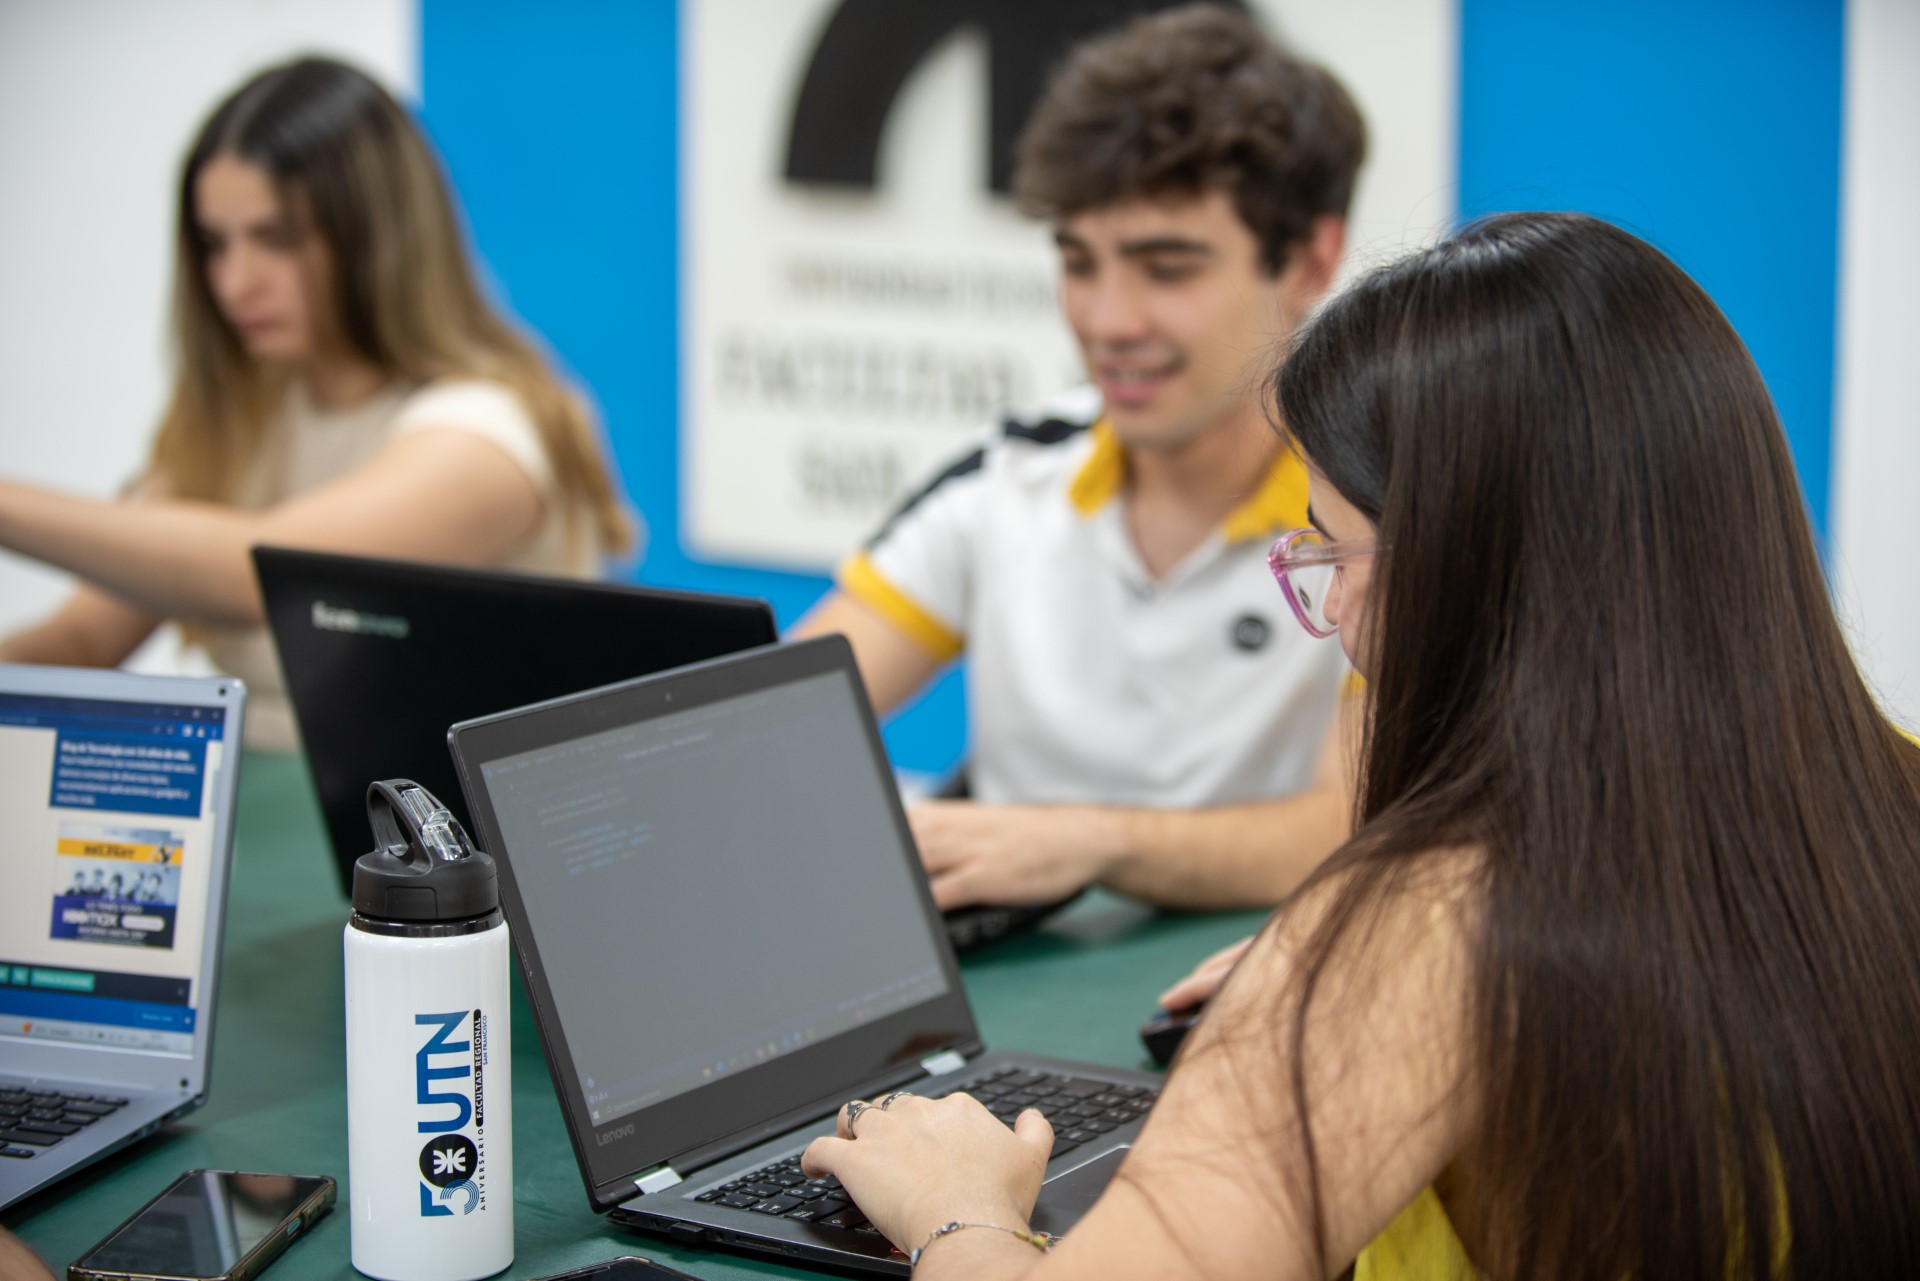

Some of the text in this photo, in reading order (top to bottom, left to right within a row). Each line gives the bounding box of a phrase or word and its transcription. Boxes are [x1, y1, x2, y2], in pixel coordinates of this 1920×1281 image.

[415, 1010, 472, 1133] UTN
[474, 1018, 486, 1211] ANIVERSARIO FACULTAD REGIONAL
[595, 1124, 635, 1147] Lenovo
